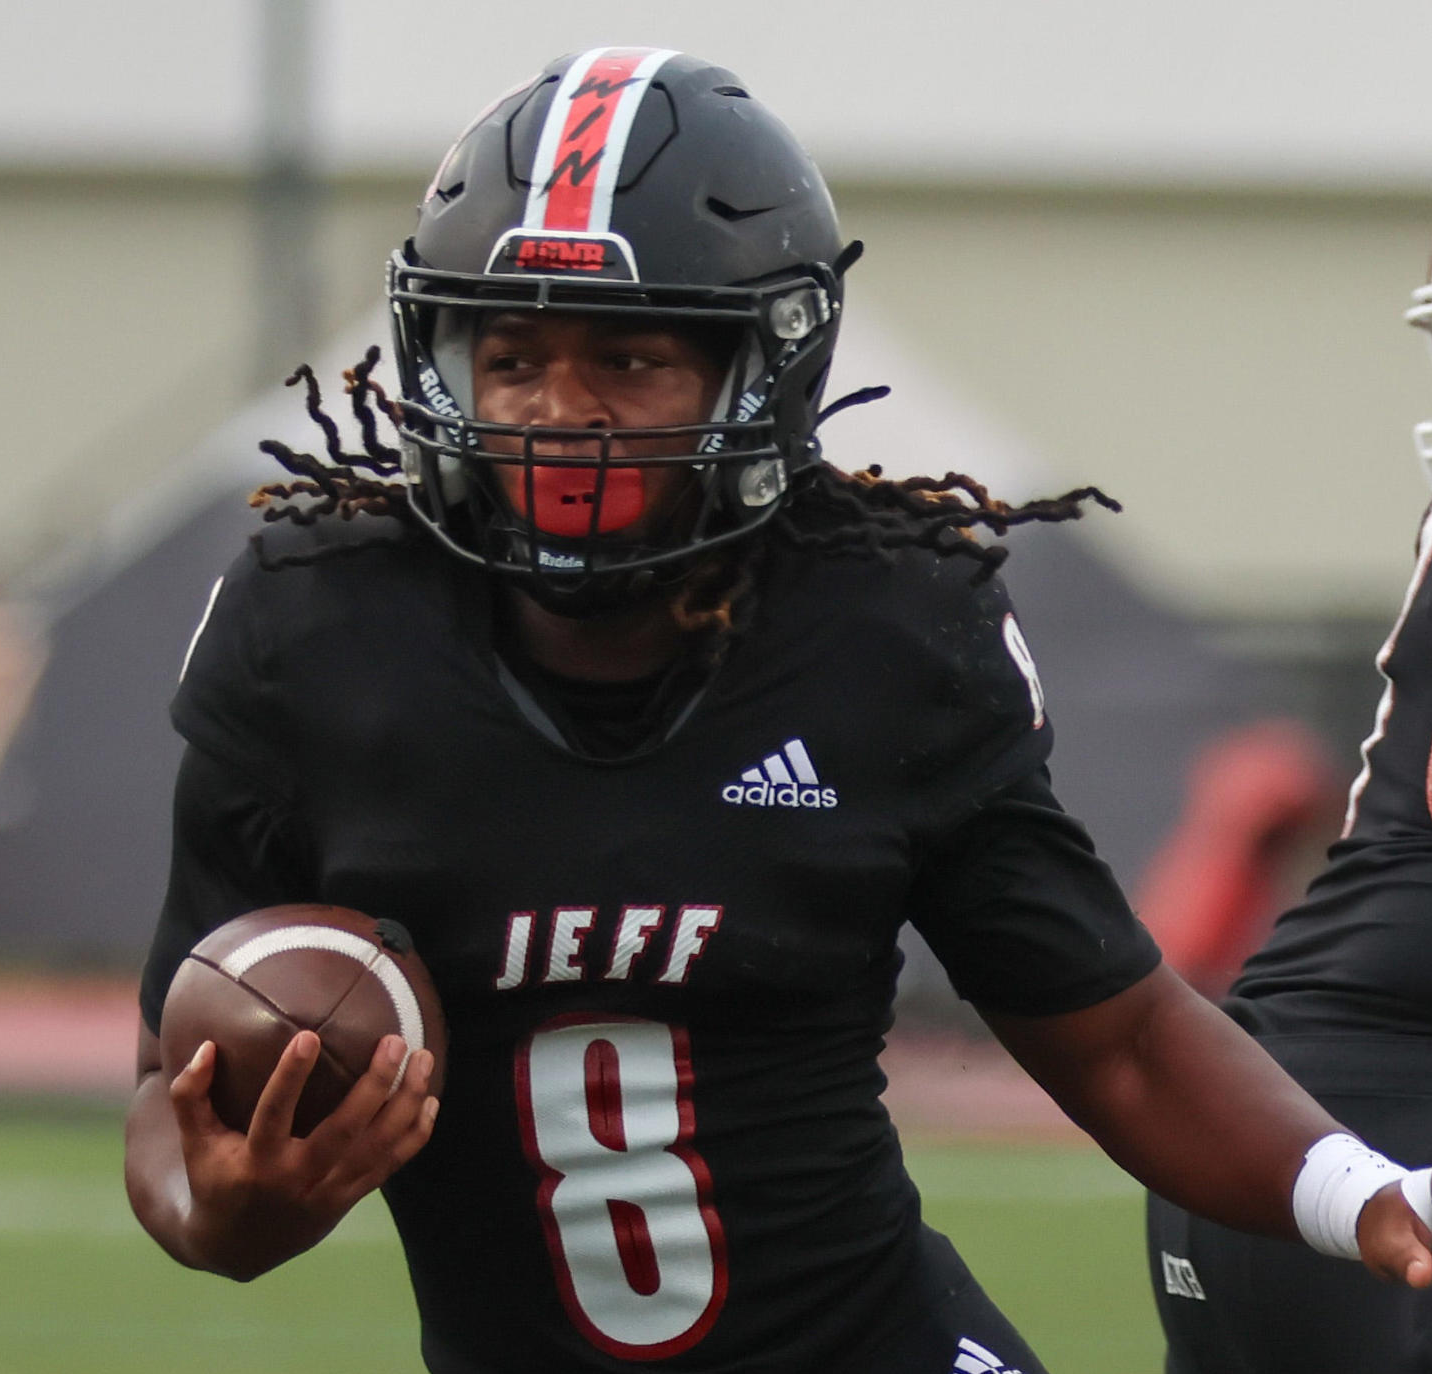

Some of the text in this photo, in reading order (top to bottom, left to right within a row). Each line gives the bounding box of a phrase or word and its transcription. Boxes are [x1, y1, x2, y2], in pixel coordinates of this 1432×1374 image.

[721, 780, 839, 809] adidas
[496, 905, 724, 991] JEFF
[513, 1010, 729, 1361] 8
